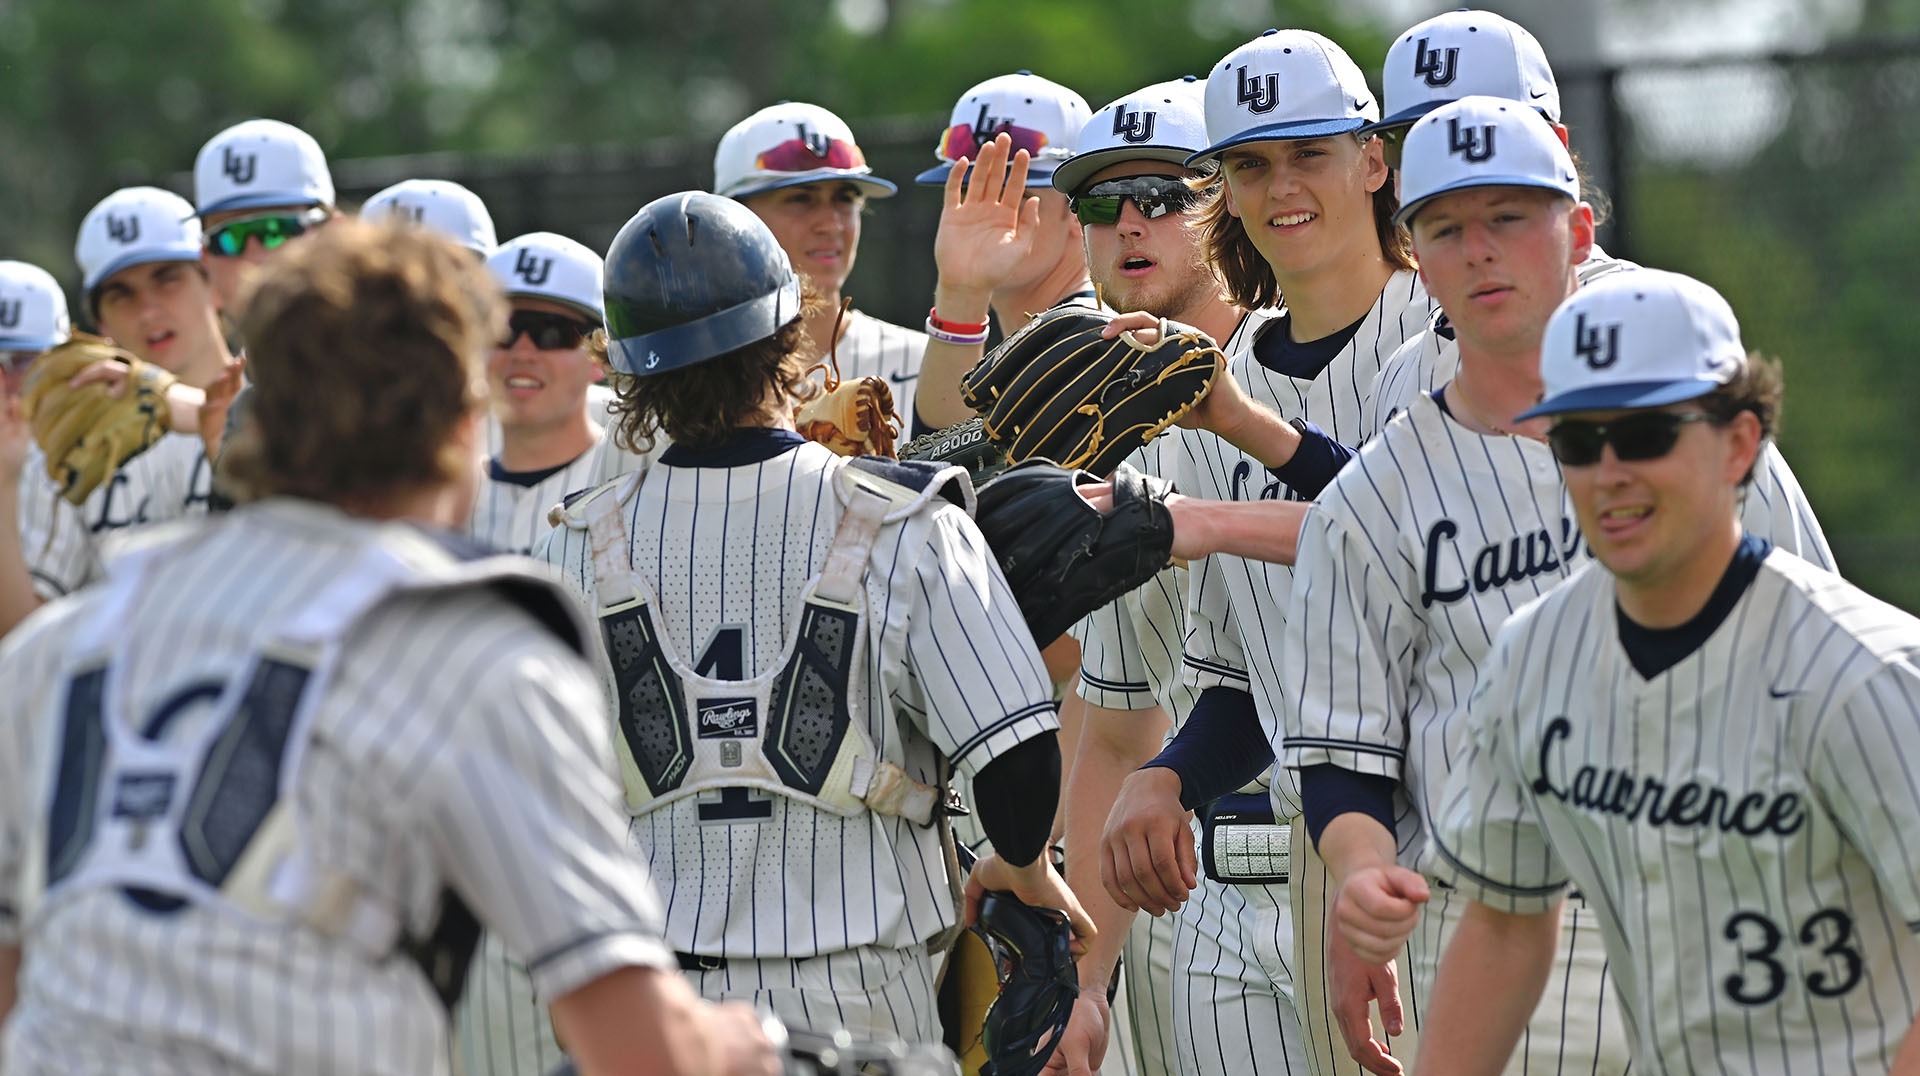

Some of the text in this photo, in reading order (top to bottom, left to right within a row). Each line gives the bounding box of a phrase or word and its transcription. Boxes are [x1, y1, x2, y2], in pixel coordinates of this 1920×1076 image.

[1413, 36, 1460, 89] LU
[1236, 64, 1280, 116] LU
[1113, 103, 1157, 145] LU
[1446, 116, 1497, 165] LU
[223, 147, 256, 185] LU
[106, 213, 140, 244] LU
[514, 247, 553, 287] LU
[1574, 312, 1621, 372] LU
[930, 430, 983, 461] A2000
[702, 707, 752, 729] Rawlings
[1532, 716, 1806, 838] Lawrence
[1723, 907, 1864, 1006] 33
